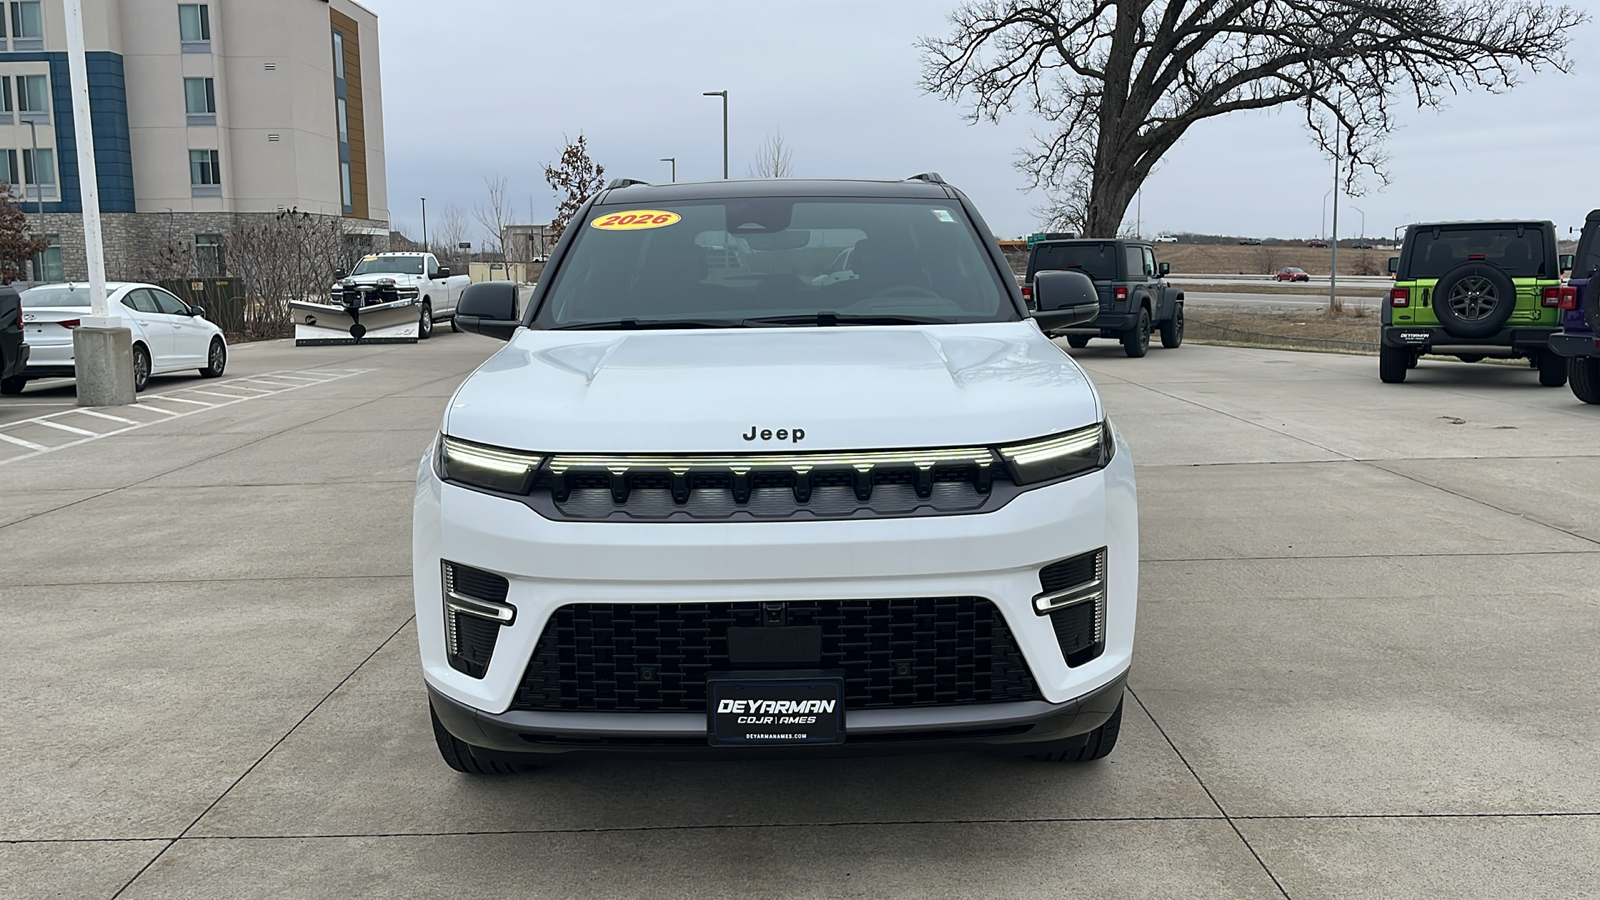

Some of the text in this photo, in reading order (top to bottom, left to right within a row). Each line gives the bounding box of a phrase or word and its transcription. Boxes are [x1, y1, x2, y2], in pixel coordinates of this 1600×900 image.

[599, 214, 672, 227] 2026
[742, 426, 805, 443] Jeep
[717, 699, 836, 714] DEYARMAN
[779, 716, 816, 724] AMES
